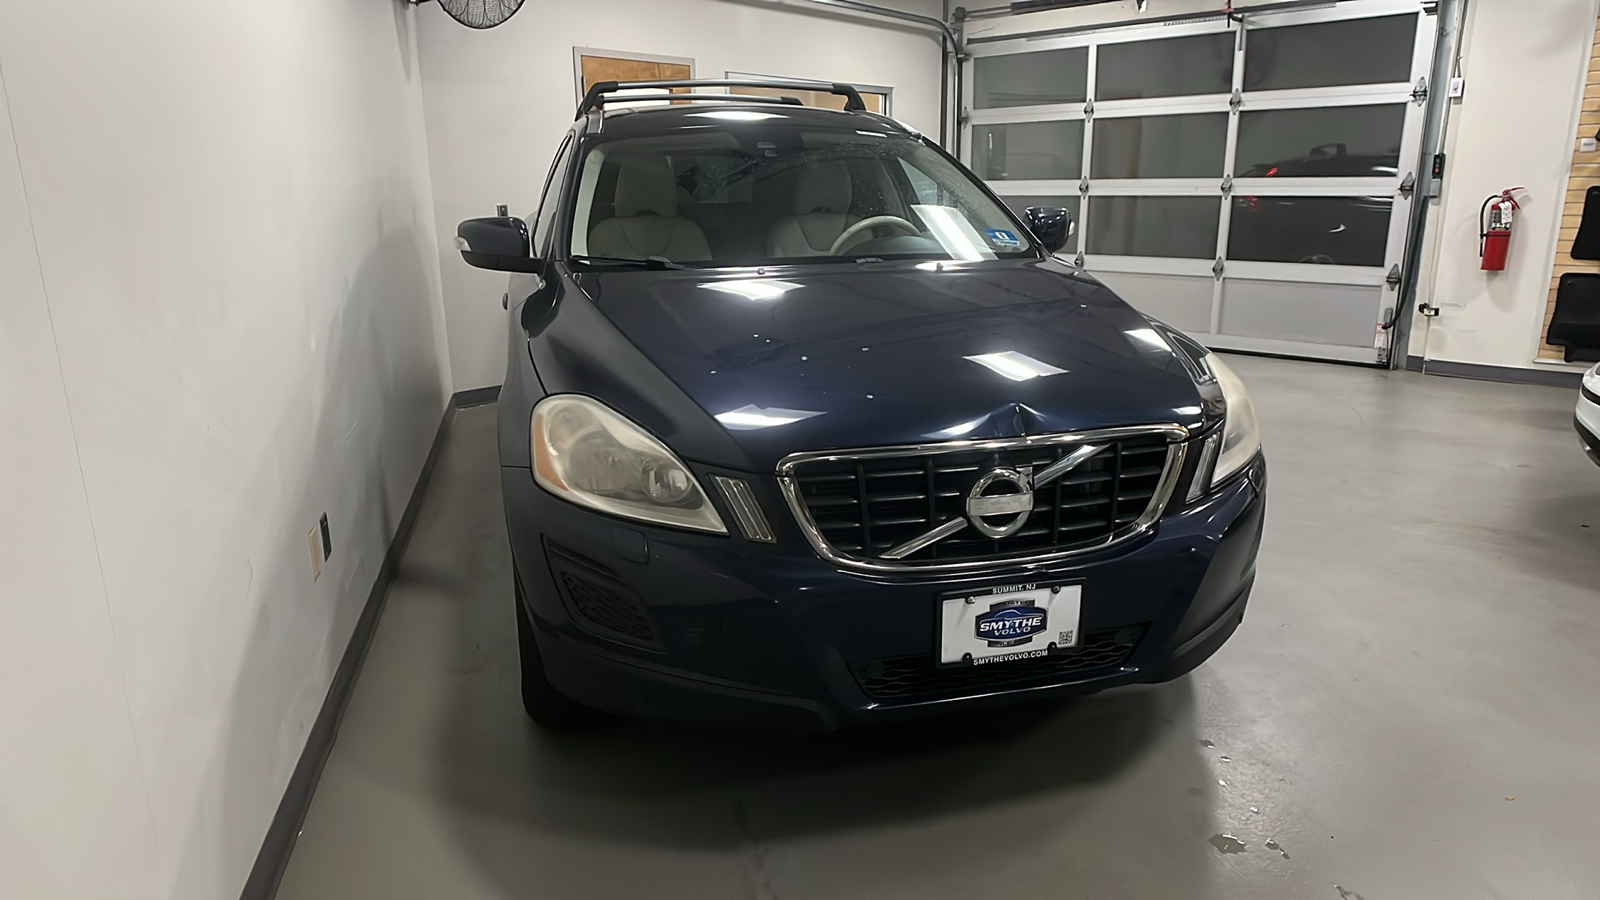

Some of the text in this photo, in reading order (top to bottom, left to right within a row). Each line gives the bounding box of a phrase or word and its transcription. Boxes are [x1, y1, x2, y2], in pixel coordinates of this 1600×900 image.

[1026, 583, 1036, 591] NJ
[979, 617, 1042, 632] SMYTHE
[994, 626, 1031, 636] VOLVO
[973, 650, 1048, 665] SMYTHEVOLVO.COM
